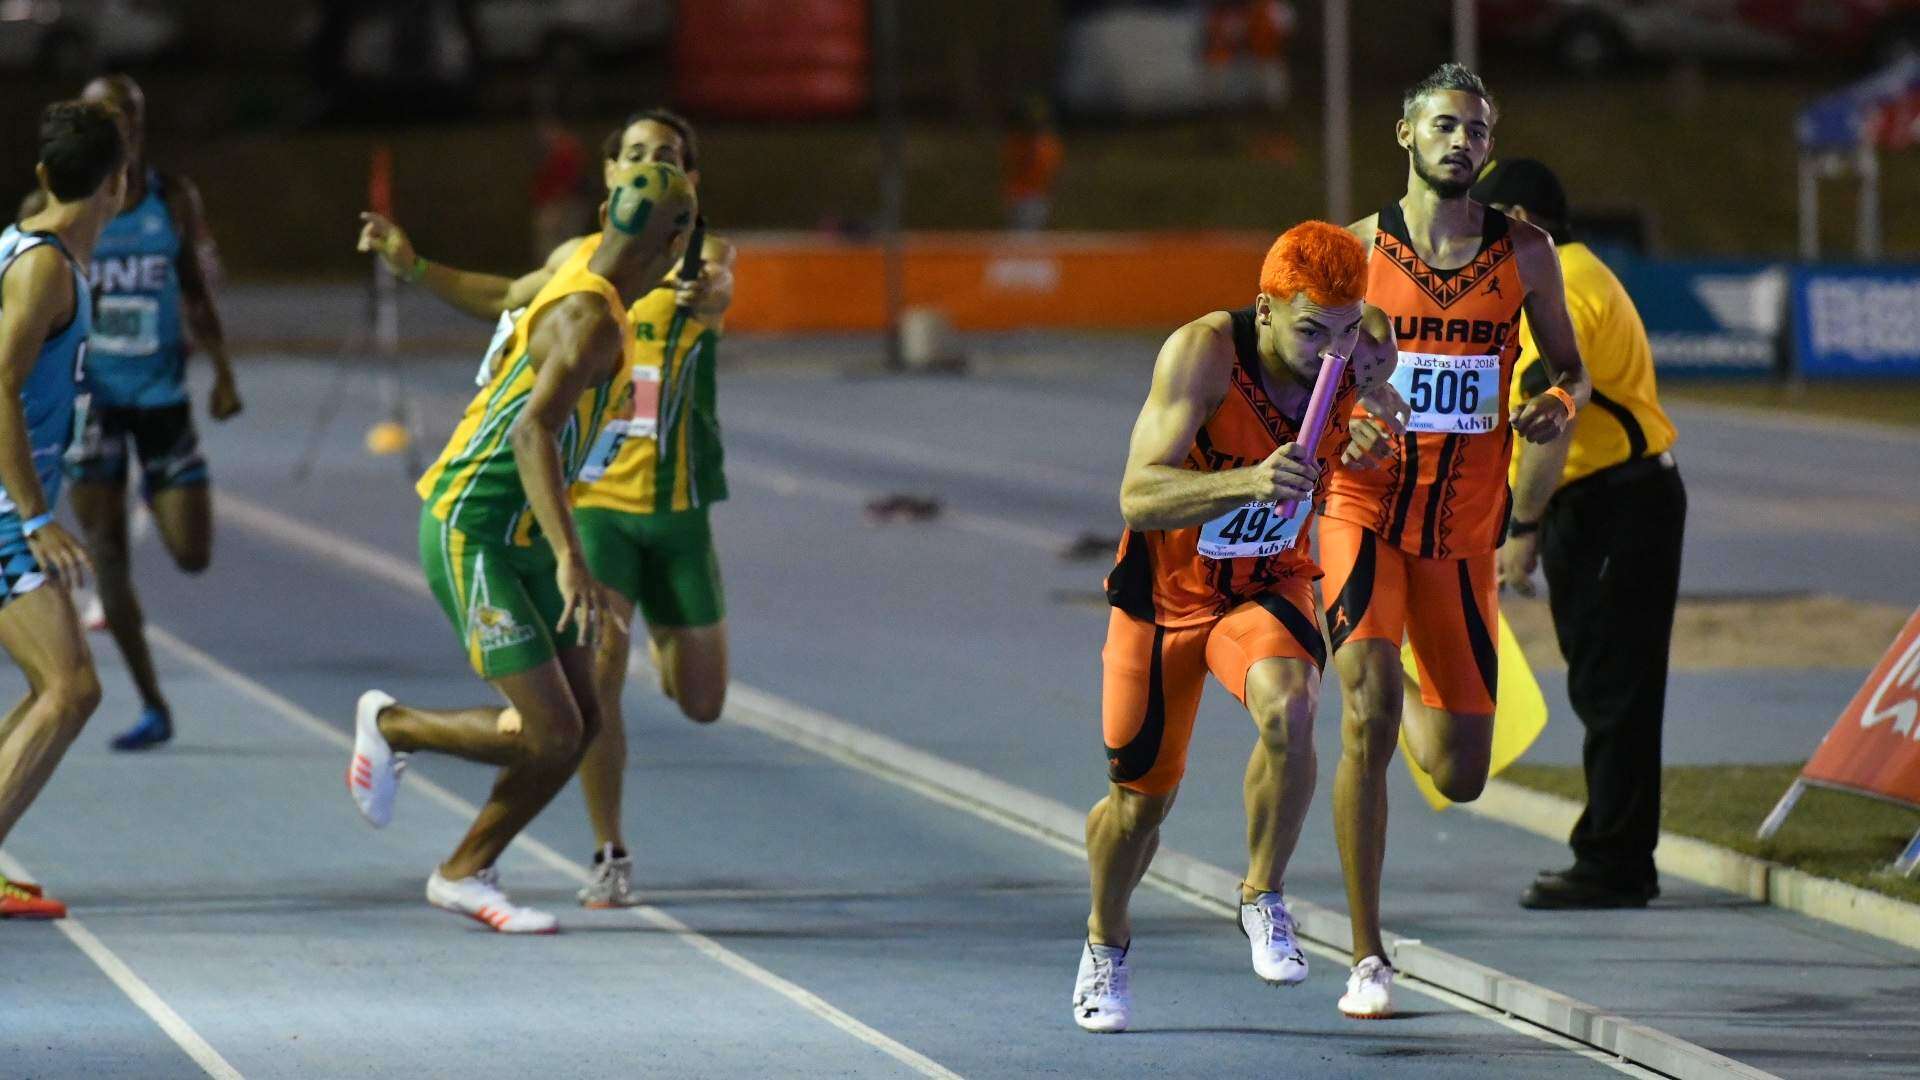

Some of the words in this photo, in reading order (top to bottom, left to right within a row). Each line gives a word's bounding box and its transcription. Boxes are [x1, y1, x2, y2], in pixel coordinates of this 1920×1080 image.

[1414, 356, 1451, 368] Justas
[1409, 367, 1480, 415] 506
[1452, 415, 1493, 431] Advil
[1218, 507, 1289, 545] 492
